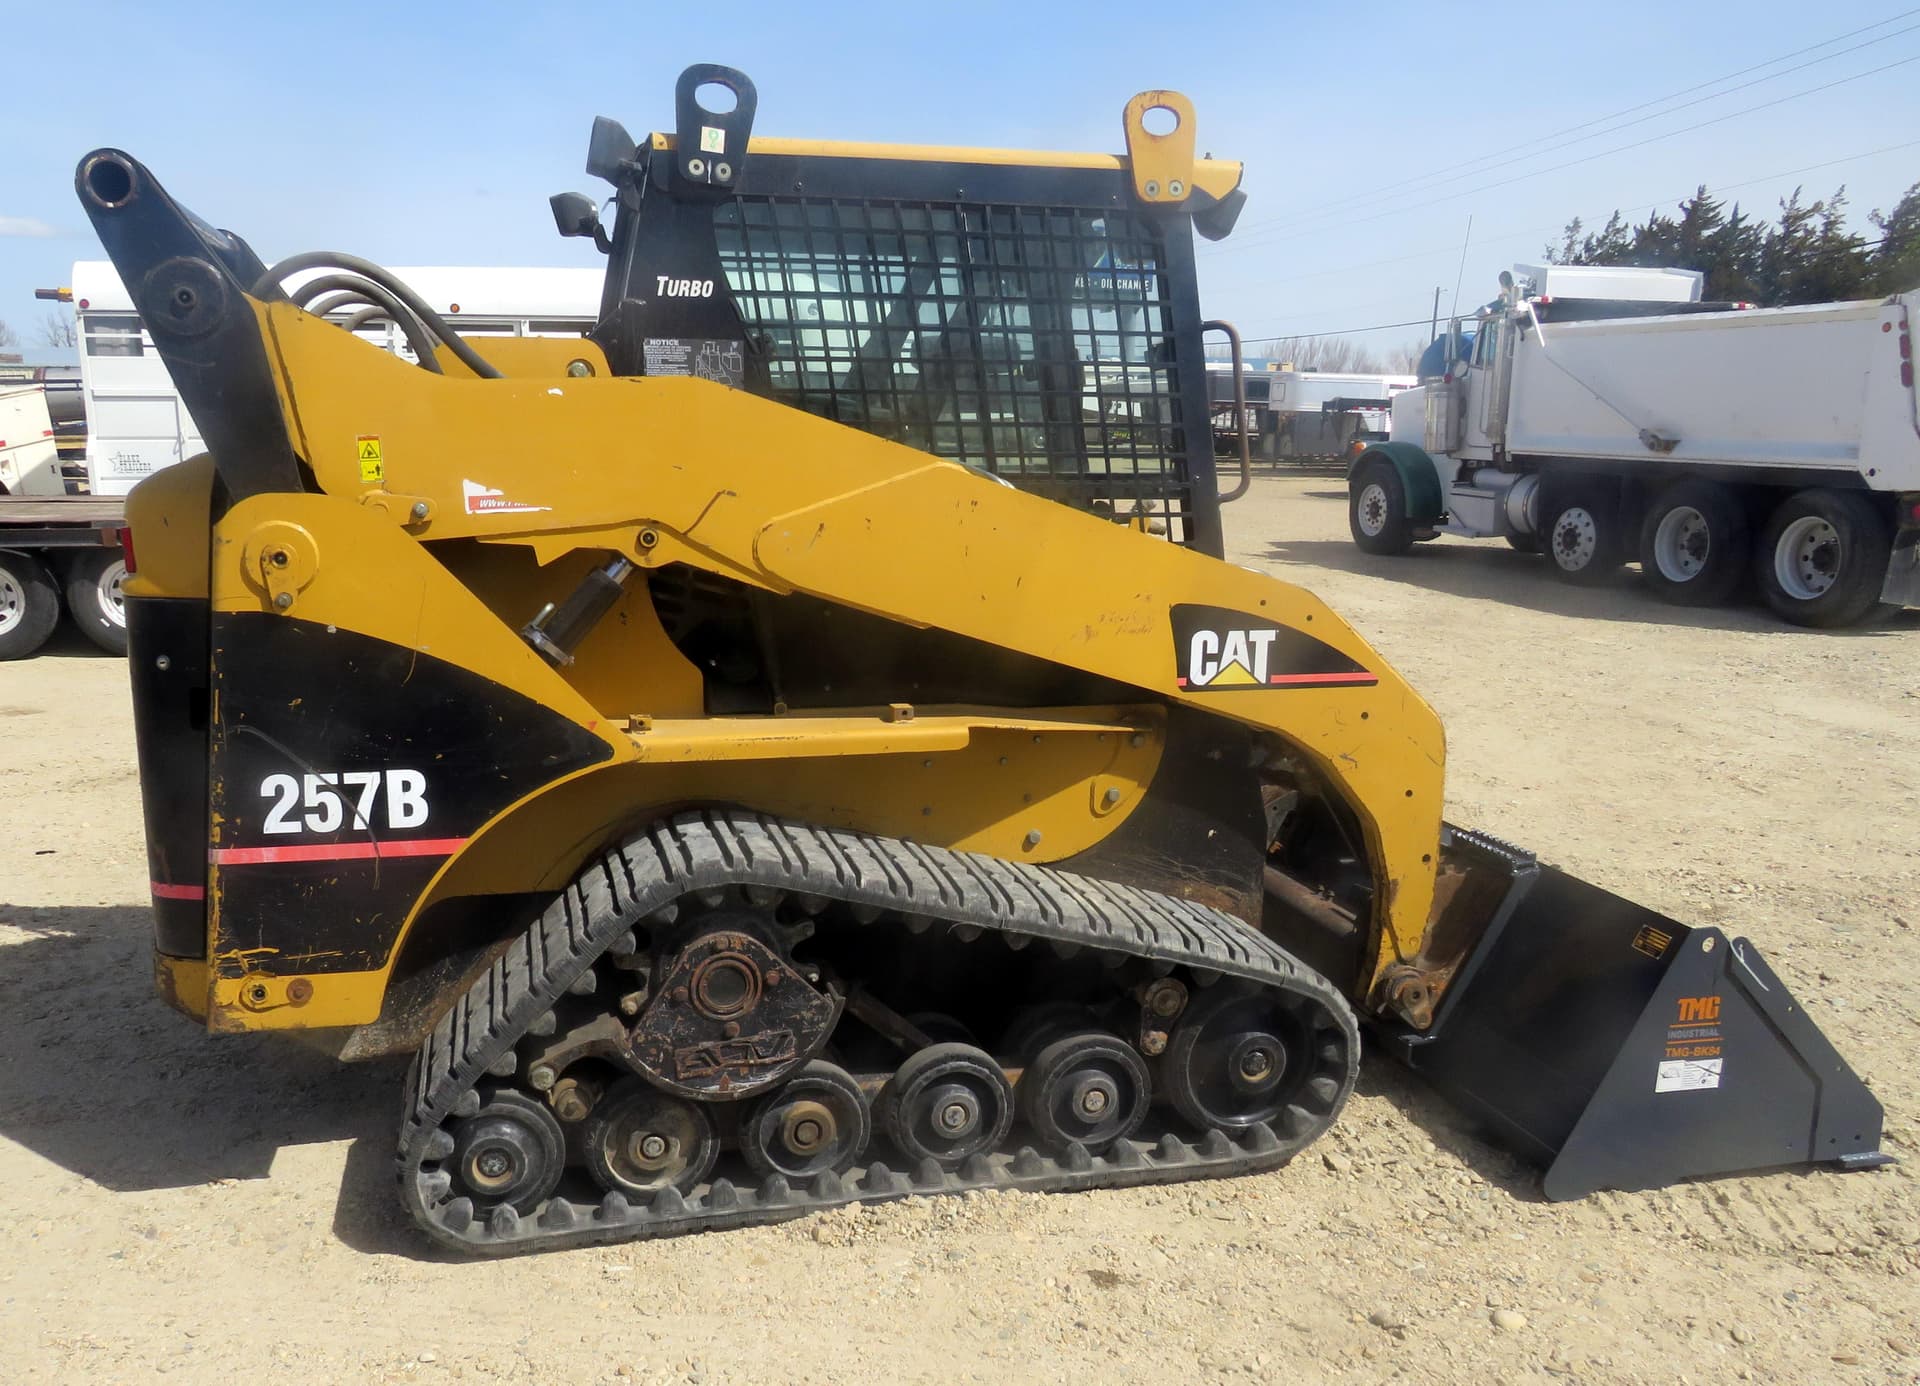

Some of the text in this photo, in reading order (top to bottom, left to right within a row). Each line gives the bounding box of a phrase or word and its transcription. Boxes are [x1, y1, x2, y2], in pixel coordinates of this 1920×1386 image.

[657, 276, 713, 298] TURBO
[1101, 278, 1113, 289] OIL
[1189, 630, 1276, 686] CAT
[260, 769, 429, 834] 257B
[1678, 996, 1720, 1021] TMG
[1667, 1028, 1720, 1040] INDUSTRIAL
